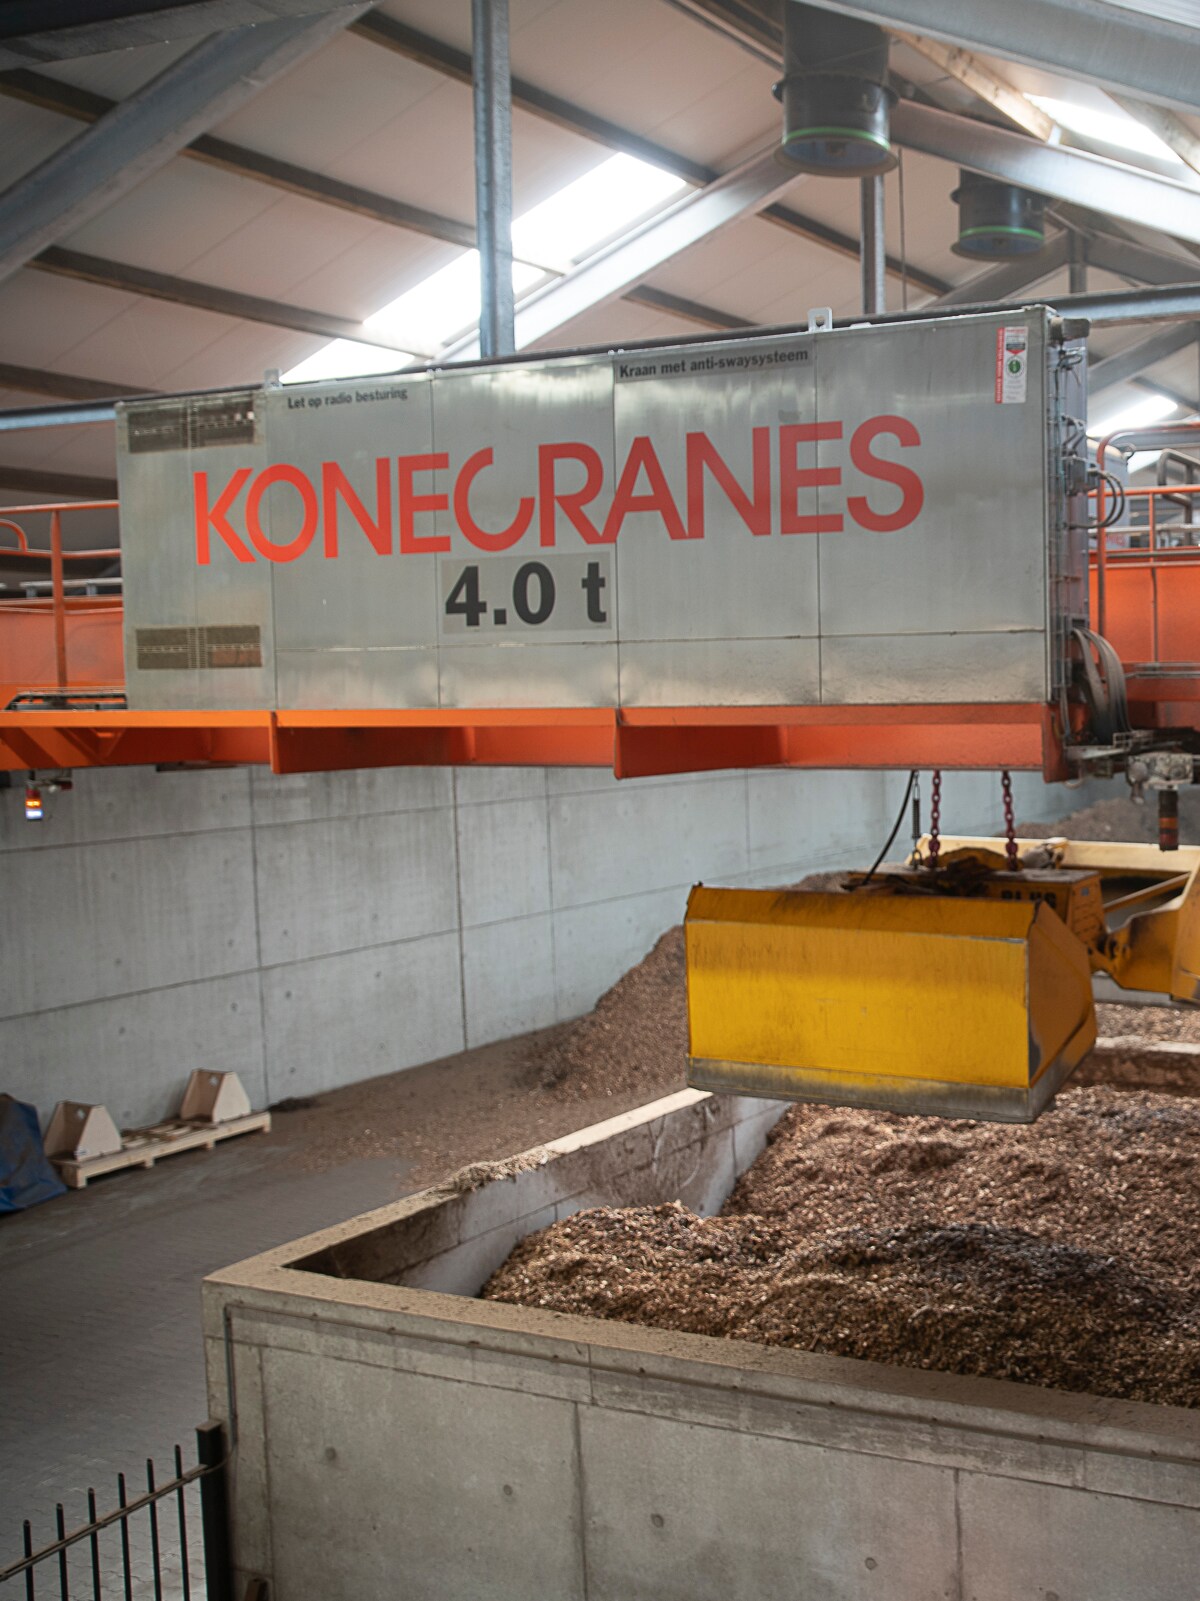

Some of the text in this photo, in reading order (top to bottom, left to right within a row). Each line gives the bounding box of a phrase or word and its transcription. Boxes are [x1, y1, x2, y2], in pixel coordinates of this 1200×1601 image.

[619, 350, 809, 379] Kraan met anti-swaysysteem
[288, 387, 408, 409] Let op radio besturing
[194, 415, 925, 565] KONECRANES
[445, 561, 607, 628] 4.0 t
